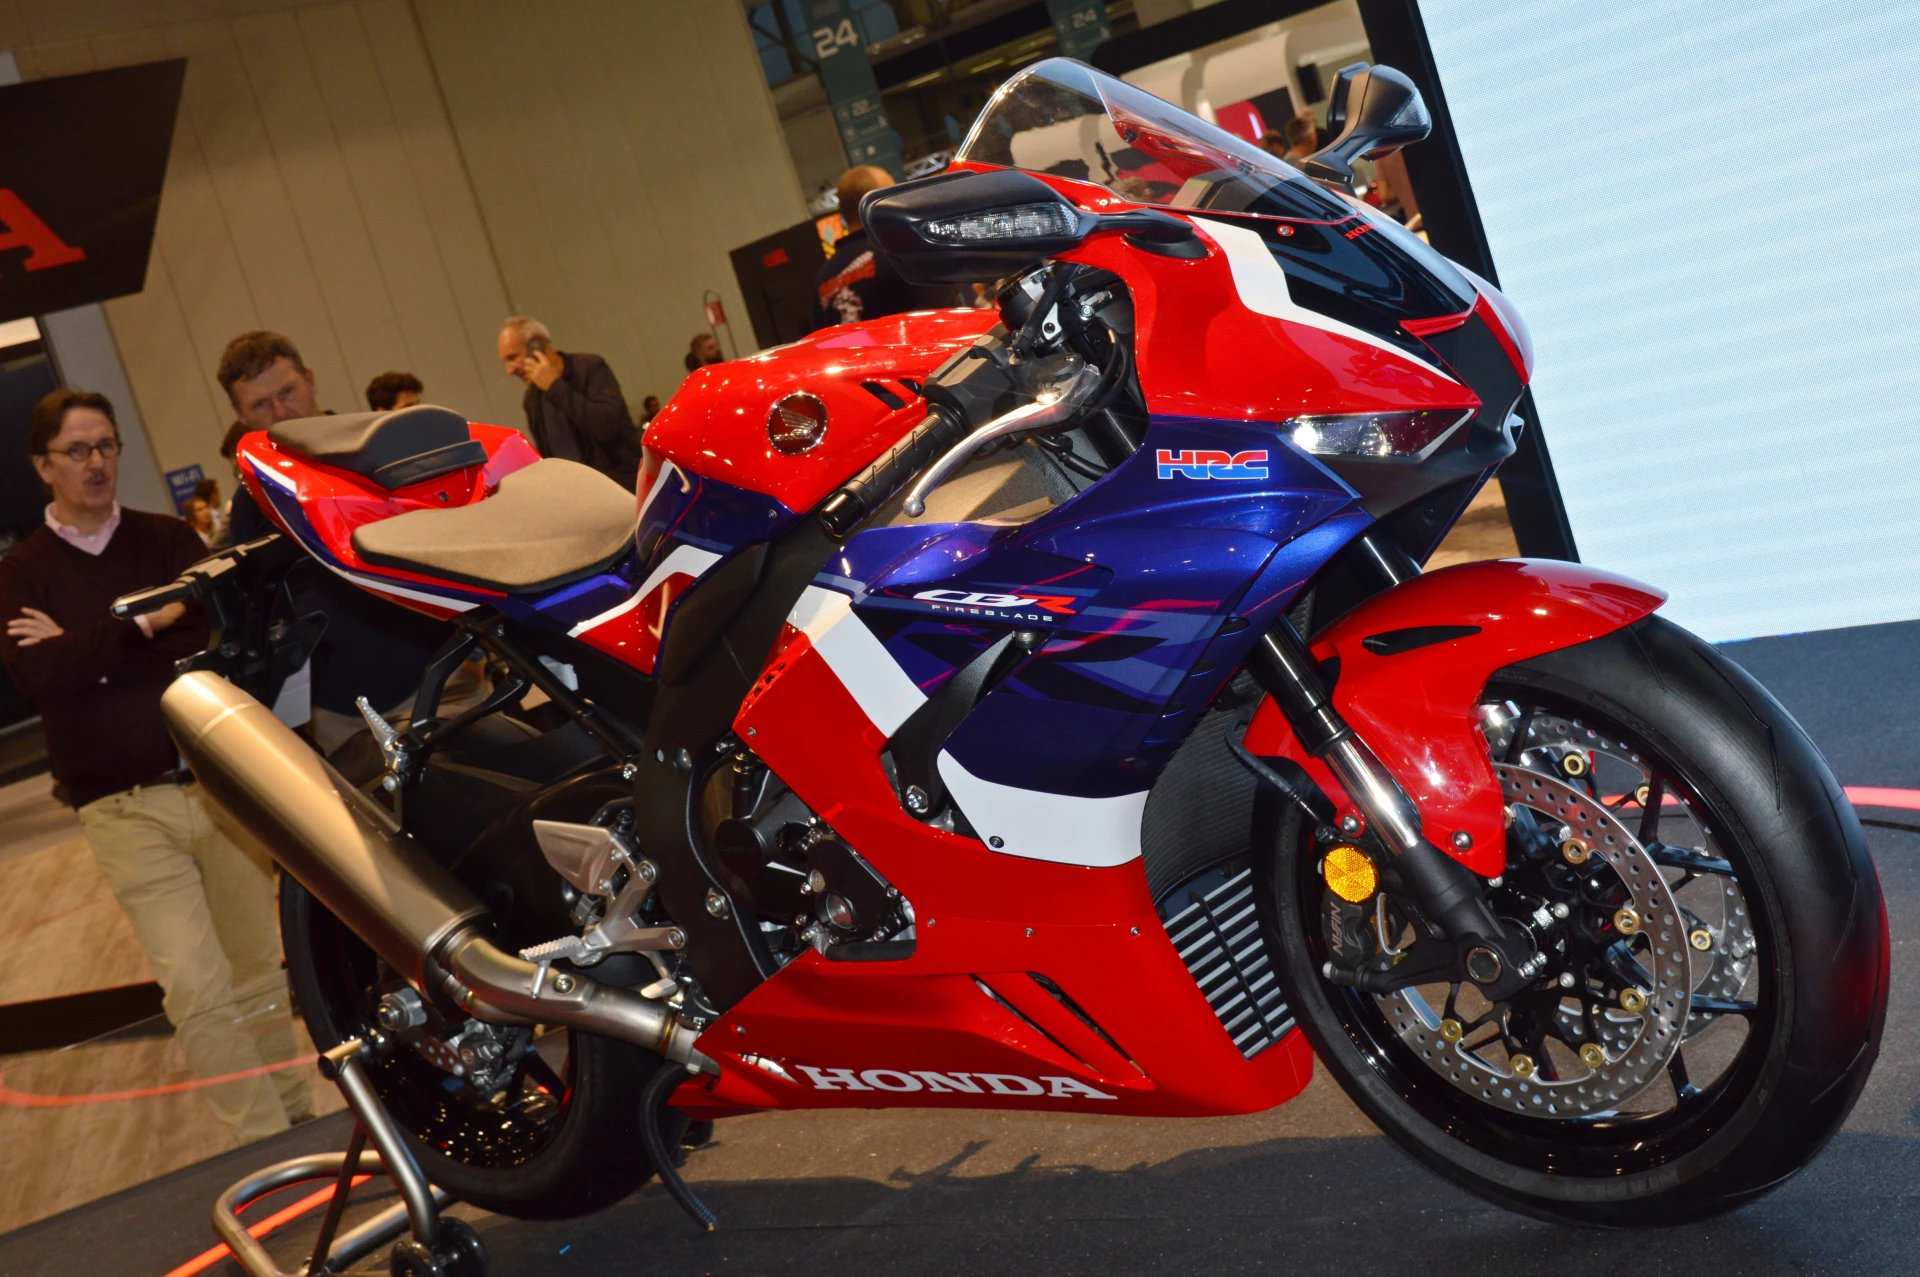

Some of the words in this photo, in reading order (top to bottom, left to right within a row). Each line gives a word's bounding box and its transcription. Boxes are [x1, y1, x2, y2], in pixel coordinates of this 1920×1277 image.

[813, 18, 858, 58] 24
[1156, 449, 1269, 480] HRC
[913, 589, 1077, 615] CBR
[931, 604, 1053, 622] FIREBLADE
[795, 1064, 1119, 1100] HONDA
